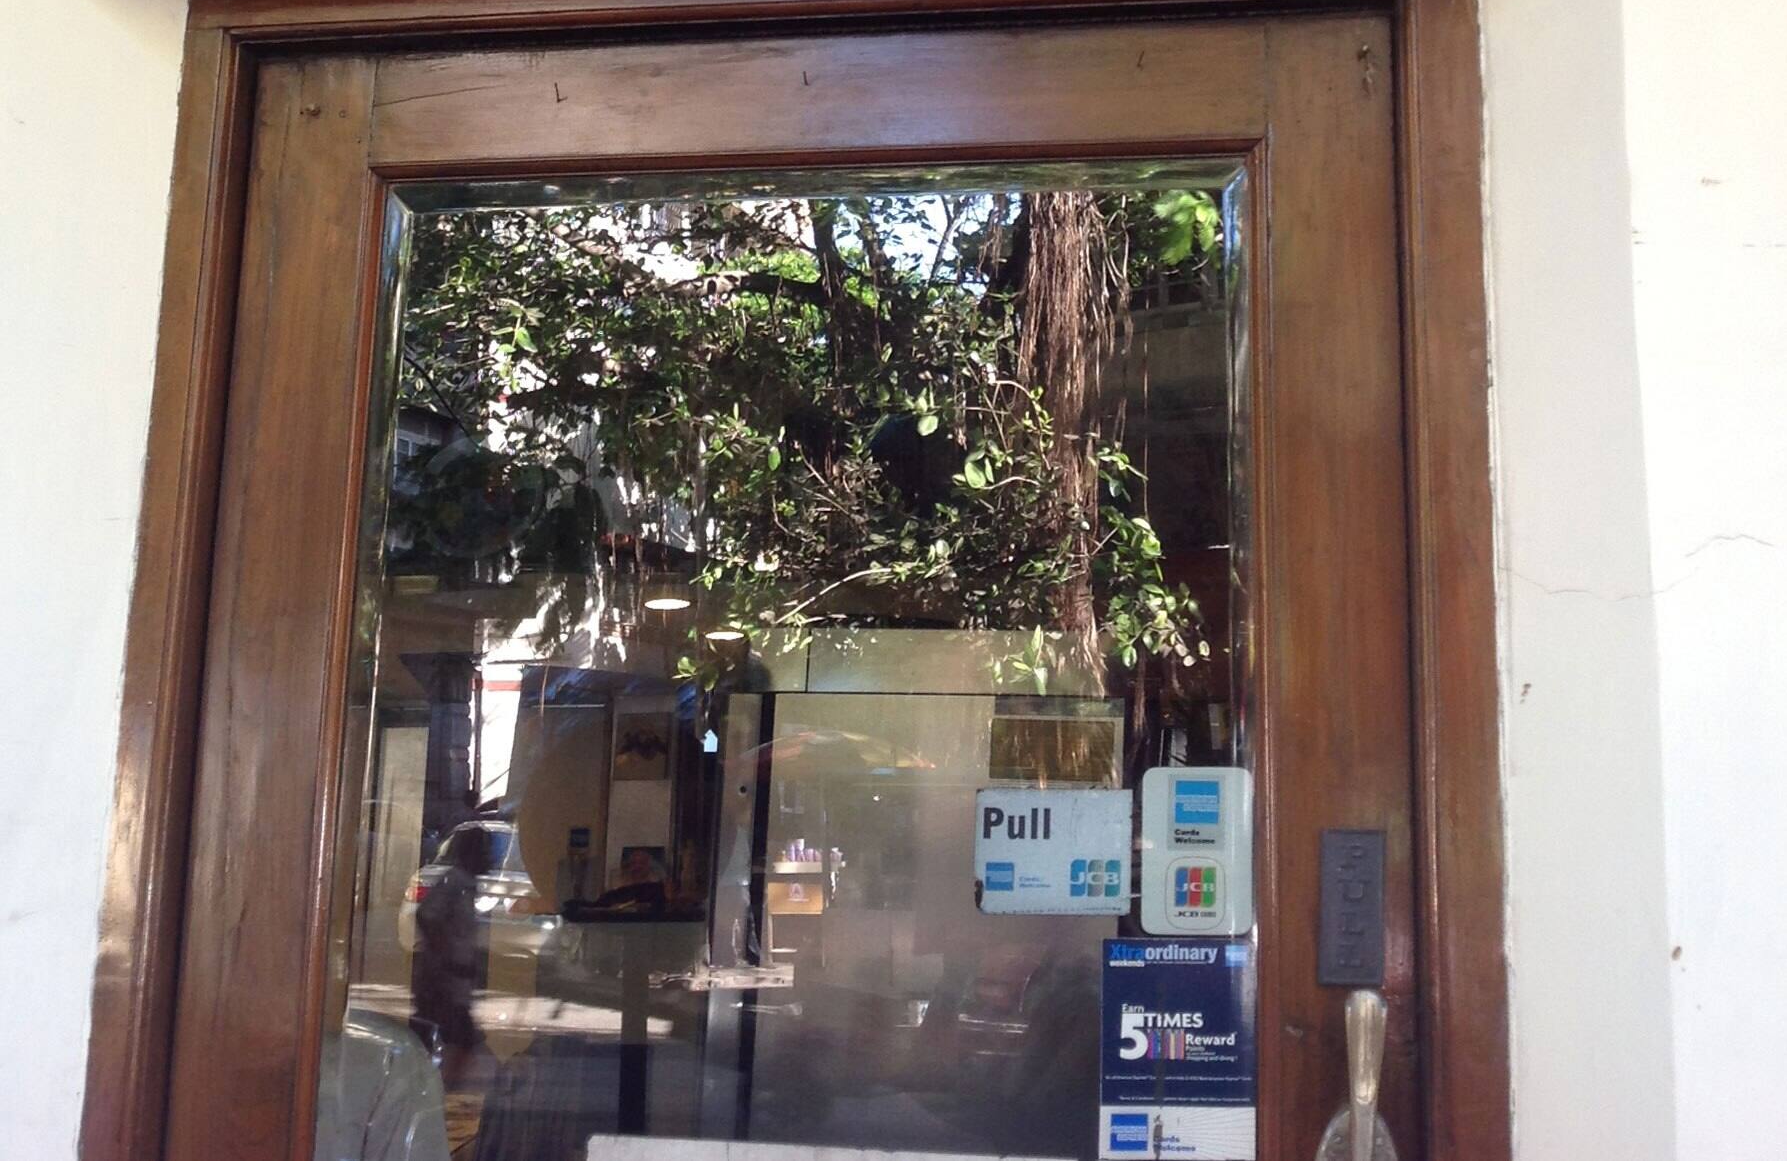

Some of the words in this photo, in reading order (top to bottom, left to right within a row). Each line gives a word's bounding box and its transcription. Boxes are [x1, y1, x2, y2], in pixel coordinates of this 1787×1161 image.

[983, 807, 1051, 840] Pull
[1070, 872, 1120, 885] JCB
[1111, 944, 1218, 964] Xtraordinary
[1121, 1004, 1145, 1013] Earn
[1143, 1013, 1204, 1028] TIMES
[1120, 1013, 1149, 1060] 5
